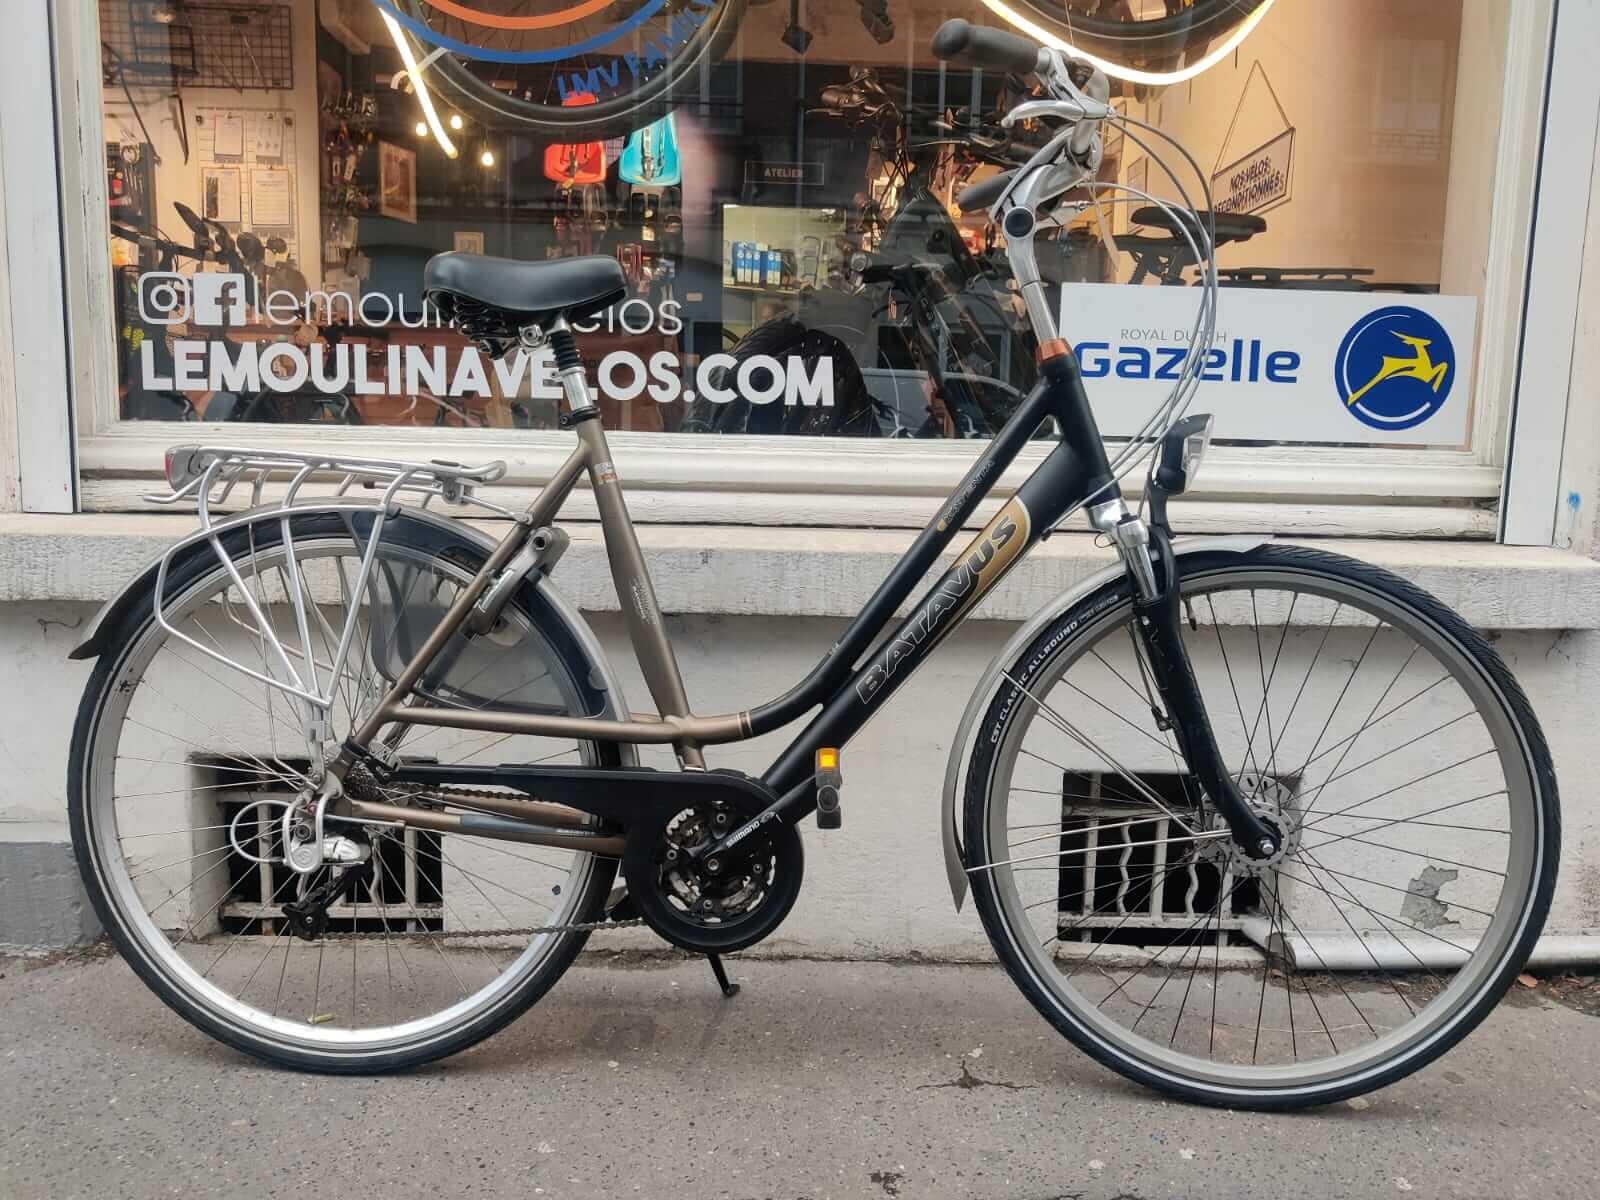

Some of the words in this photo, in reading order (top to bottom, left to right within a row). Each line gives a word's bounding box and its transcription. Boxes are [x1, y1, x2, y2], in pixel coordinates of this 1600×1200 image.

[557, 58, 619, 101] LMV
[764, 167, 803, 178] ATELIER
[1120, 328, 1168, 341] ROYAL
[141, 340, 835, 407] LEMOULINAVEOS.COM
[1073, 339, 1301, 384] Gazelle
[856, 515, 1017, 705] BATAVUS
[990, 722, 1002, 744] CST
[1027, 620, 1079, 674] ALLROUND
